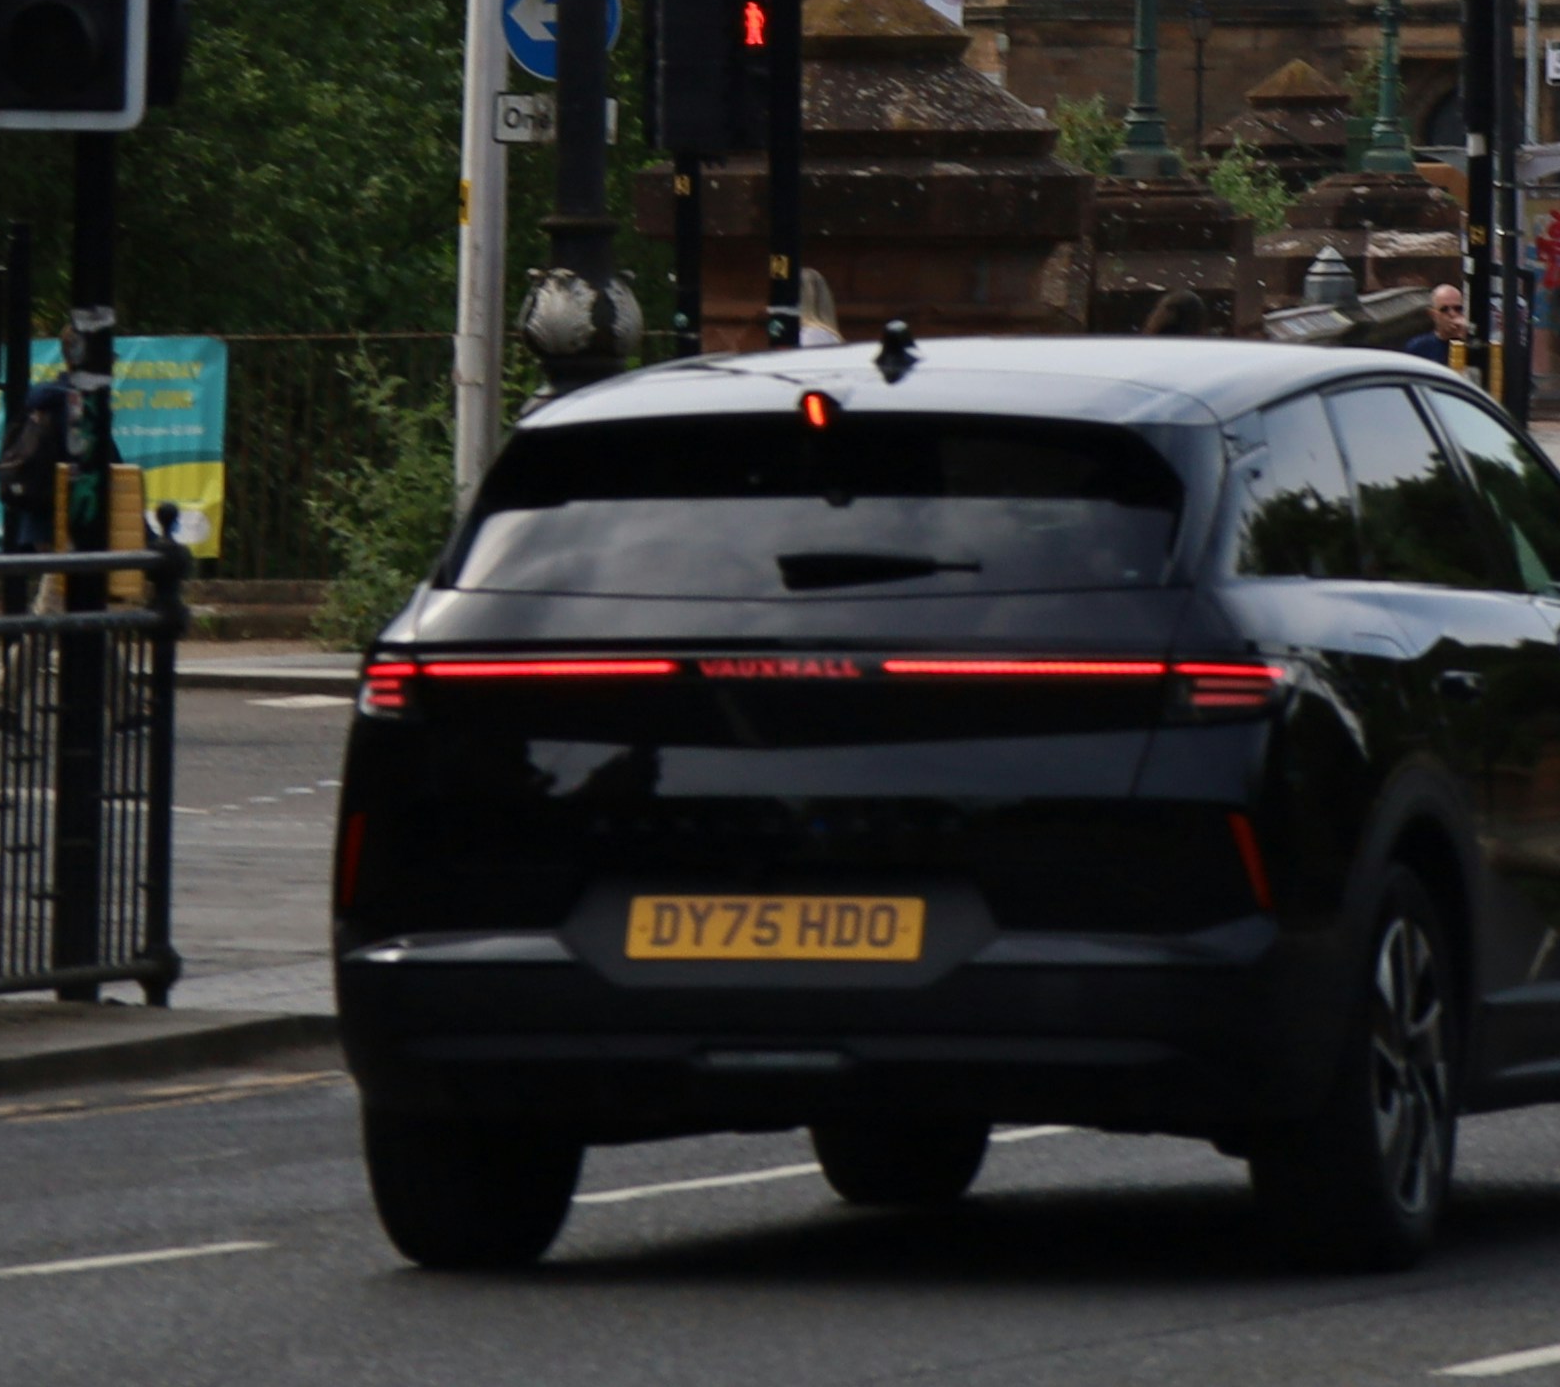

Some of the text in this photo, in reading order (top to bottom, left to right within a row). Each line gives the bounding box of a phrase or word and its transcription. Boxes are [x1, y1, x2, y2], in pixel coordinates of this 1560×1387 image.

[697, 659, 861, 677] VAUXHALL
[649, 901, 899, 948] DY75 HDO
